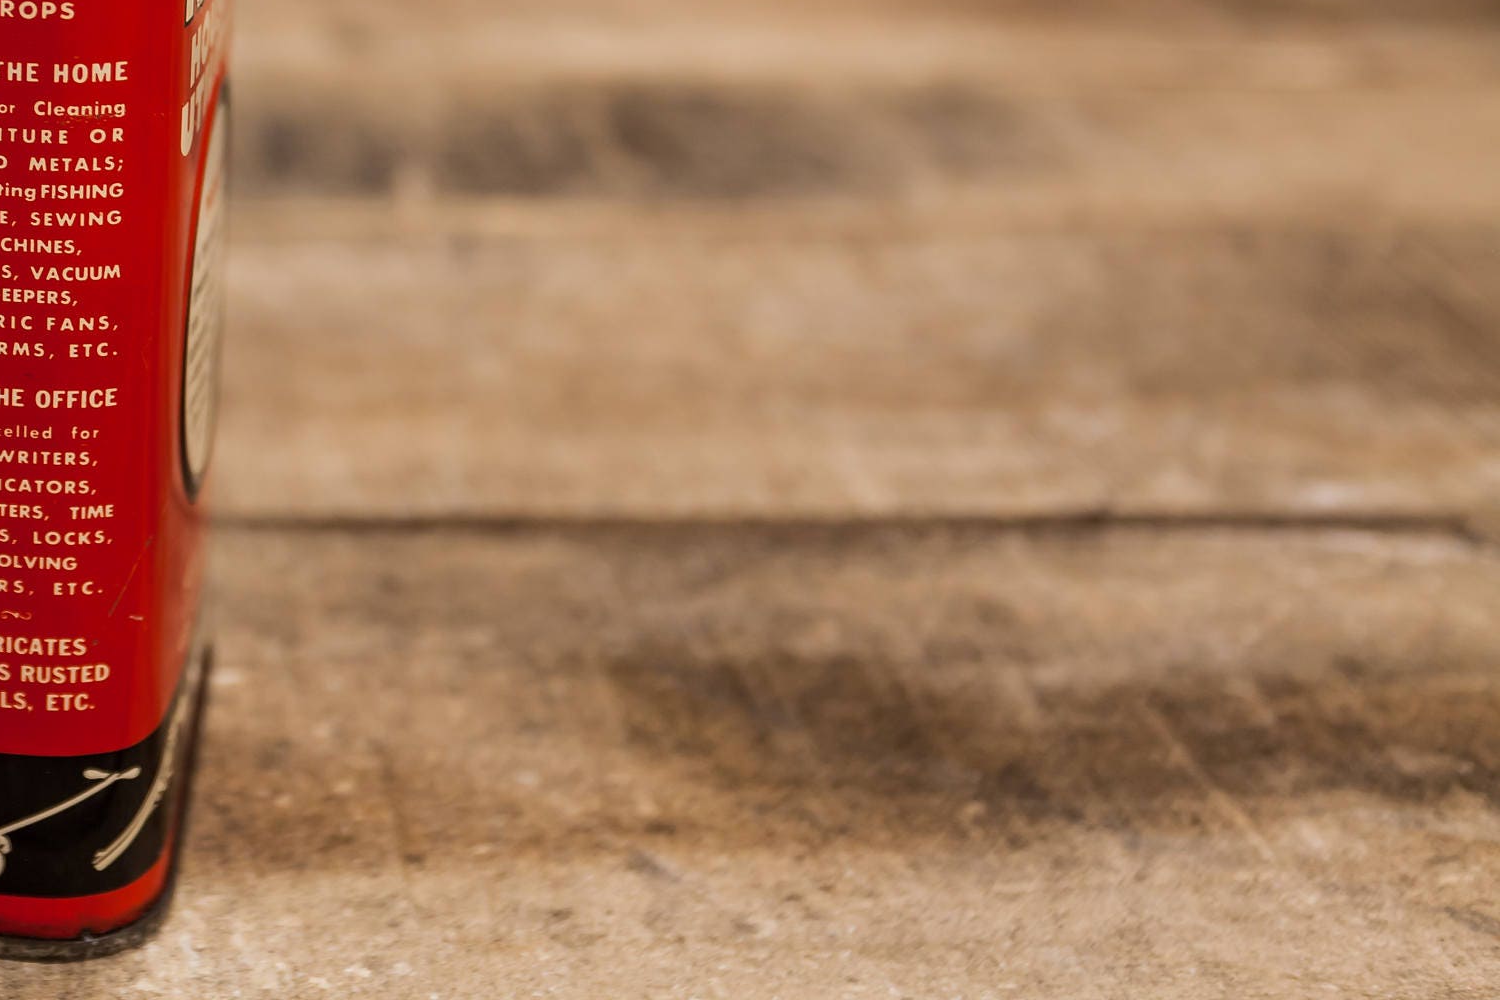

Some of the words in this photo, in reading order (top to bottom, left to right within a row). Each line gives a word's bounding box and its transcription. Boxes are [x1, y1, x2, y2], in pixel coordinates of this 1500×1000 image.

[53, 60, 128, 84] HOME
[33, 100, 126, 118] Cleaning
[89, 127, 124, 144] OR
[28, 155, 124, 172] METALS;
[40, 182, 124, 200] FISHING
[30, 209, 122, 227] SEWING
[30, 264, 121, 282] VACUUM
[46, 315, 118, 332] FANS,
[69, 342, 118, 358] ETC.
[35, 387, 118, 409] OFFICE
[71, 426, 99, 440] for
[69, 504, 114, 520] TIME
[33, 530, 112, 546] LOCKS,
[53, 581, 103, 596] ETC.
[20, 663, 110, 684] RUSTED
[46, 693, 95, 712] ETC.
